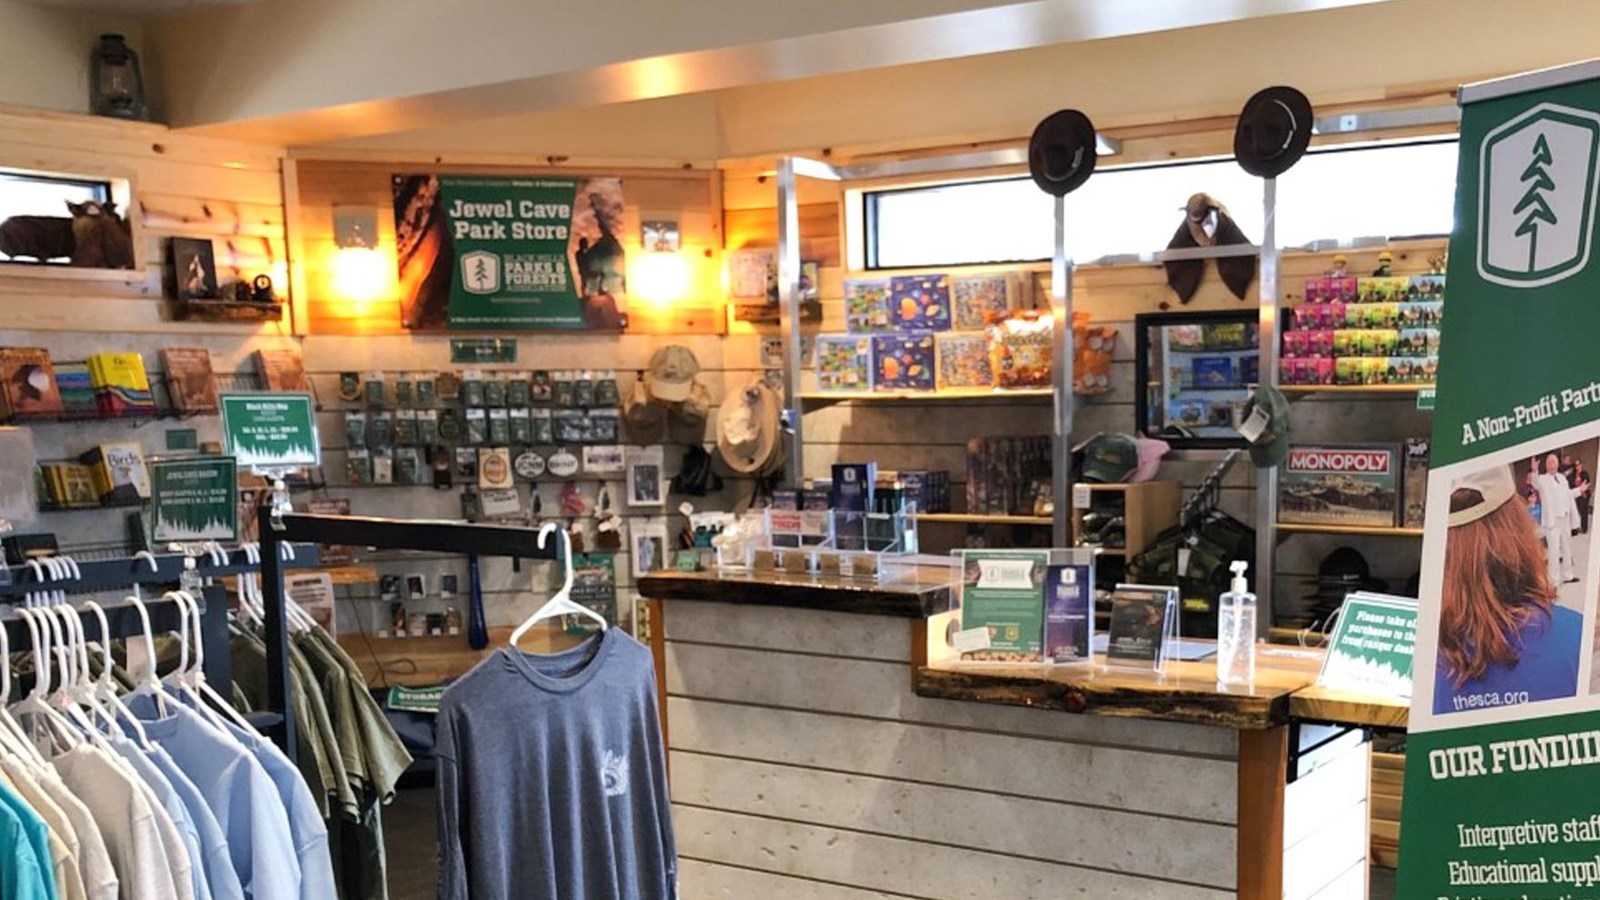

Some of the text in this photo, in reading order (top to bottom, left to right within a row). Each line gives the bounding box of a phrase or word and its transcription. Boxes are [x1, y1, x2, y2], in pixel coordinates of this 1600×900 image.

[449, 199, 570, 218] Jewel Cave
[454, 220, 568, 240] Park Store
[504, 261, 552, 273] PARKS
[505, 272, 567, 285] FORESTS
[1461, 381, 1600, 446] A Non-Profit Part
[107, 452, 142, 467] Birds
[1290, 453, 1387, 471] MONOPOLY
[1453, 691, 1529, 710] thesca.org
[1429, 745, 1487, 780] OUR
[1457, 819, 1558, 850] Interpretive
[1448, 857, 1548, 885] Educational
